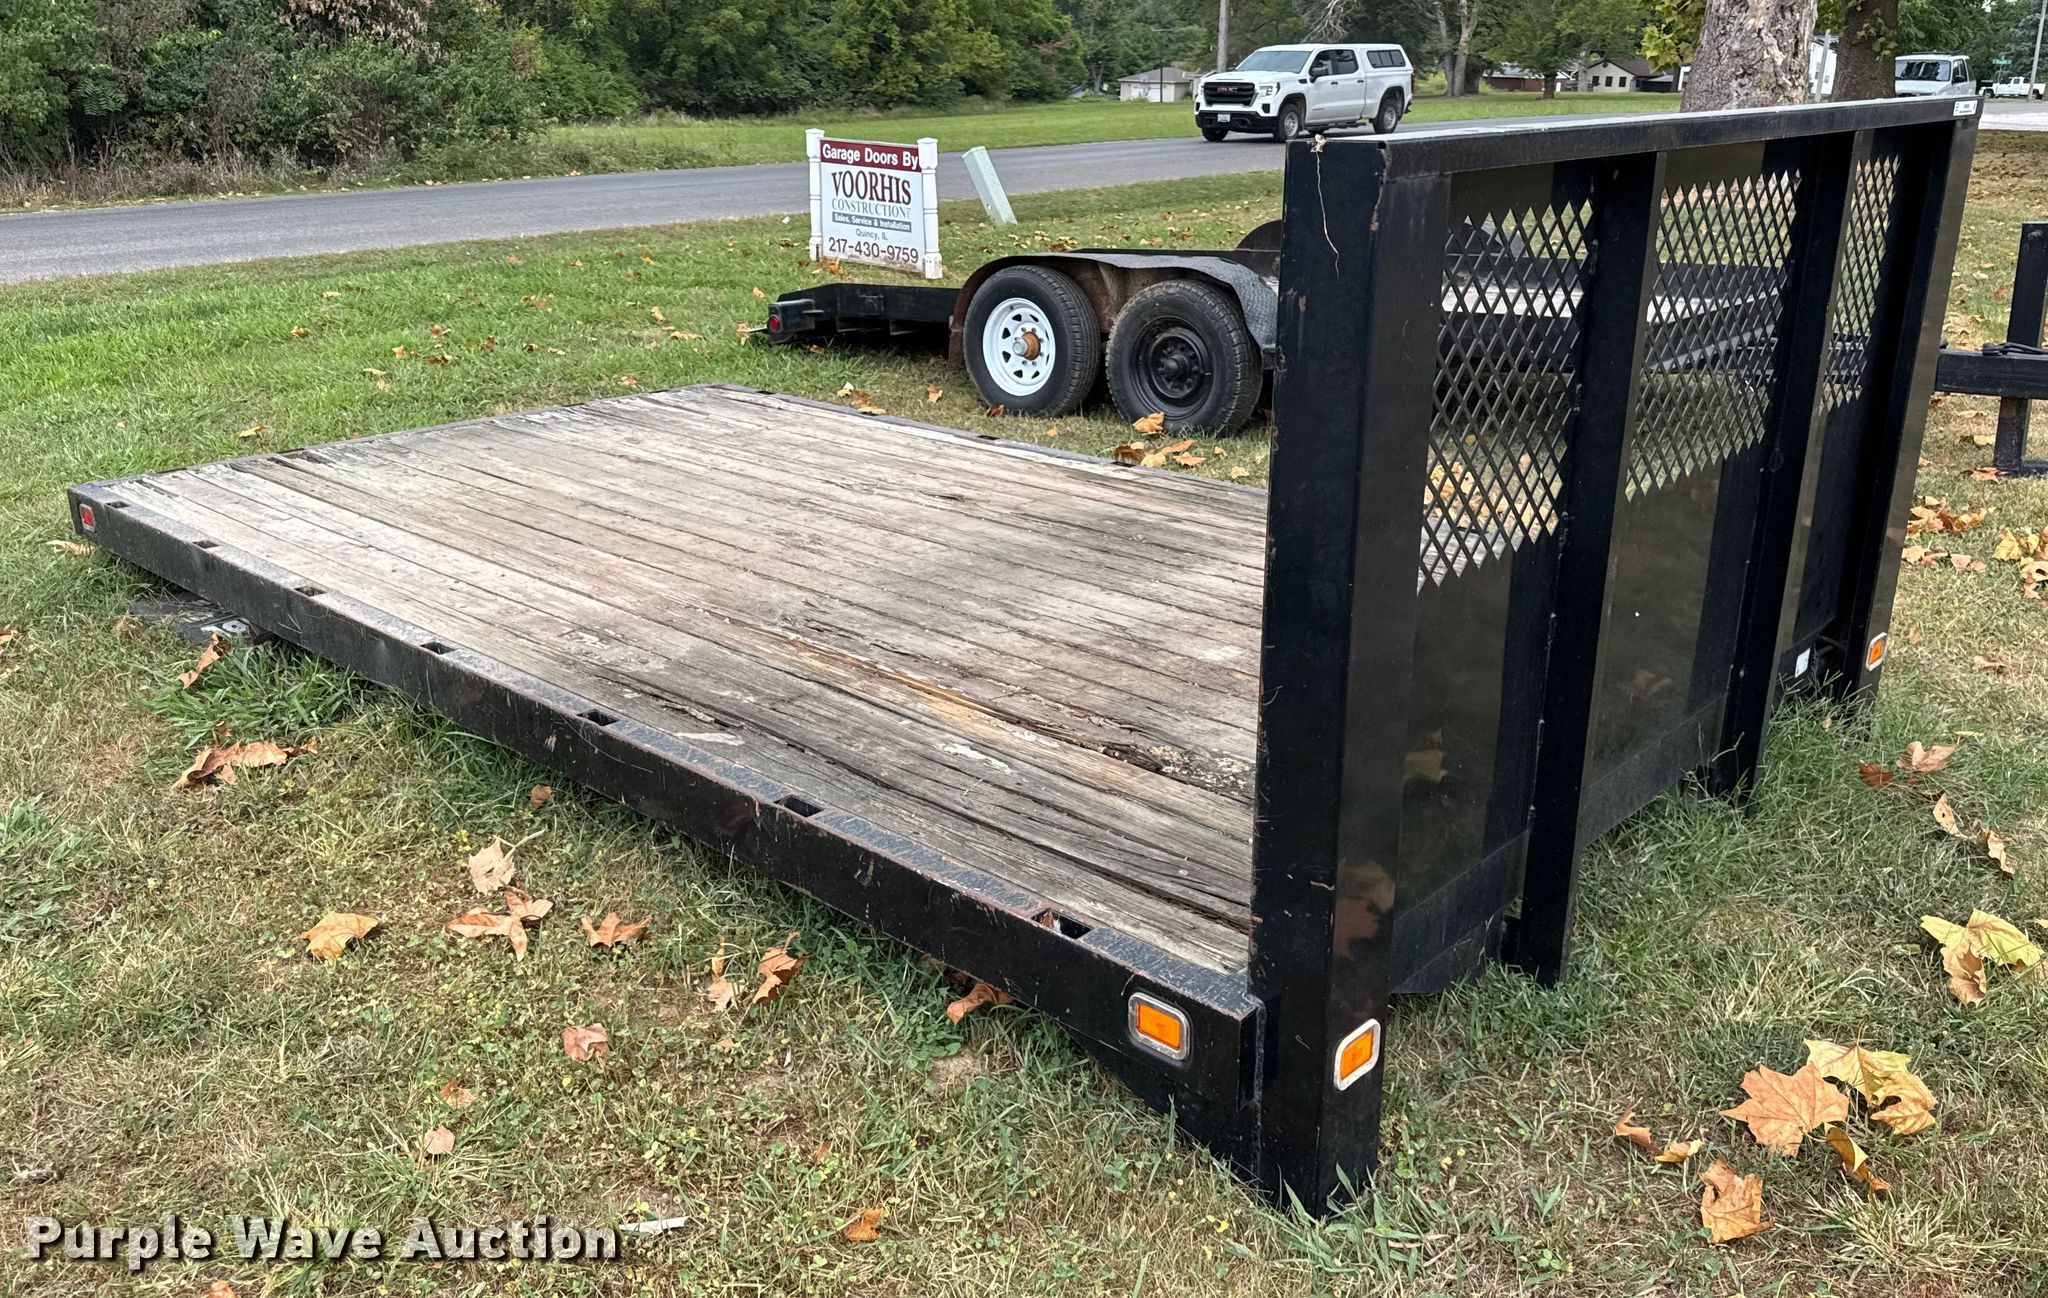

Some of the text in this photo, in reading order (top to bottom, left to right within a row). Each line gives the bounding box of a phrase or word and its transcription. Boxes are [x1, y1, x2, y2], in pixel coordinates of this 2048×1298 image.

[822, 143, 919, 170] Garage Doors By
[831, 170, 911, 205] VOORHIS
[832, 198, 906, 218] CONSTRUCTION
[851, 216, 872, 226] Service
[873, 219, 879, 227] &
[879, 219, 911, 231] Installation
[882, 232, 889, 240] IL
[829, 236, 919, 263] 217-430-9759
